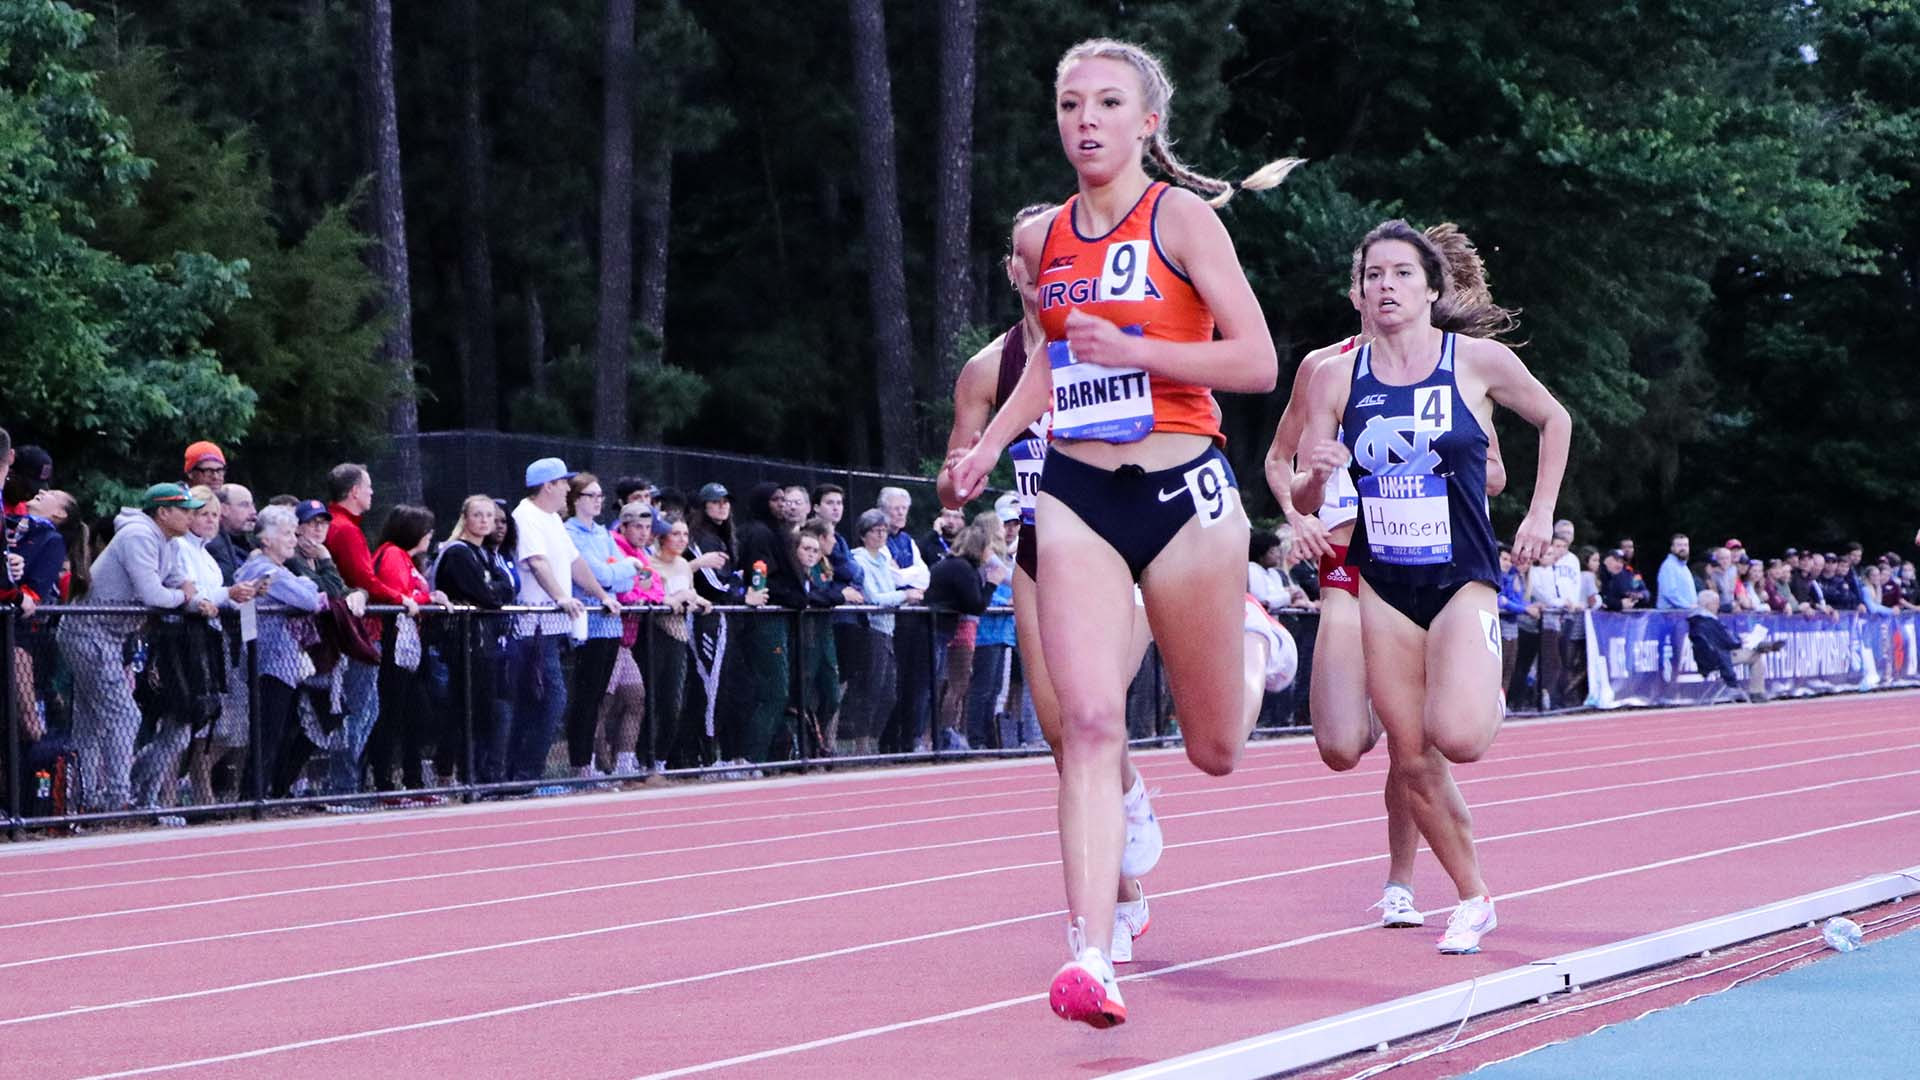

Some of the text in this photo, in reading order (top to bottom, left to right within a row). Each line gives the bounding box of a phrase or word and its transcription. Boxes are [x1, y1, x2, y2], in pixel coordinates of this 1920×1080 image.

[1110, 243, 1137, 297] 9
[1040, 277, 1164, 311] IRGIA
[1056, 371, 1147, 413] BARNETT
[1357, 393, 1389, 406] ACC
[1421, 389, 1445, 428] 4
[1197, 466, 1224, 520] 9
[1378, 475, 1426, 498] UNITE
[1369, 505, 1449, 537] Hansen
[1326, 574, 1352, 582] adidas
